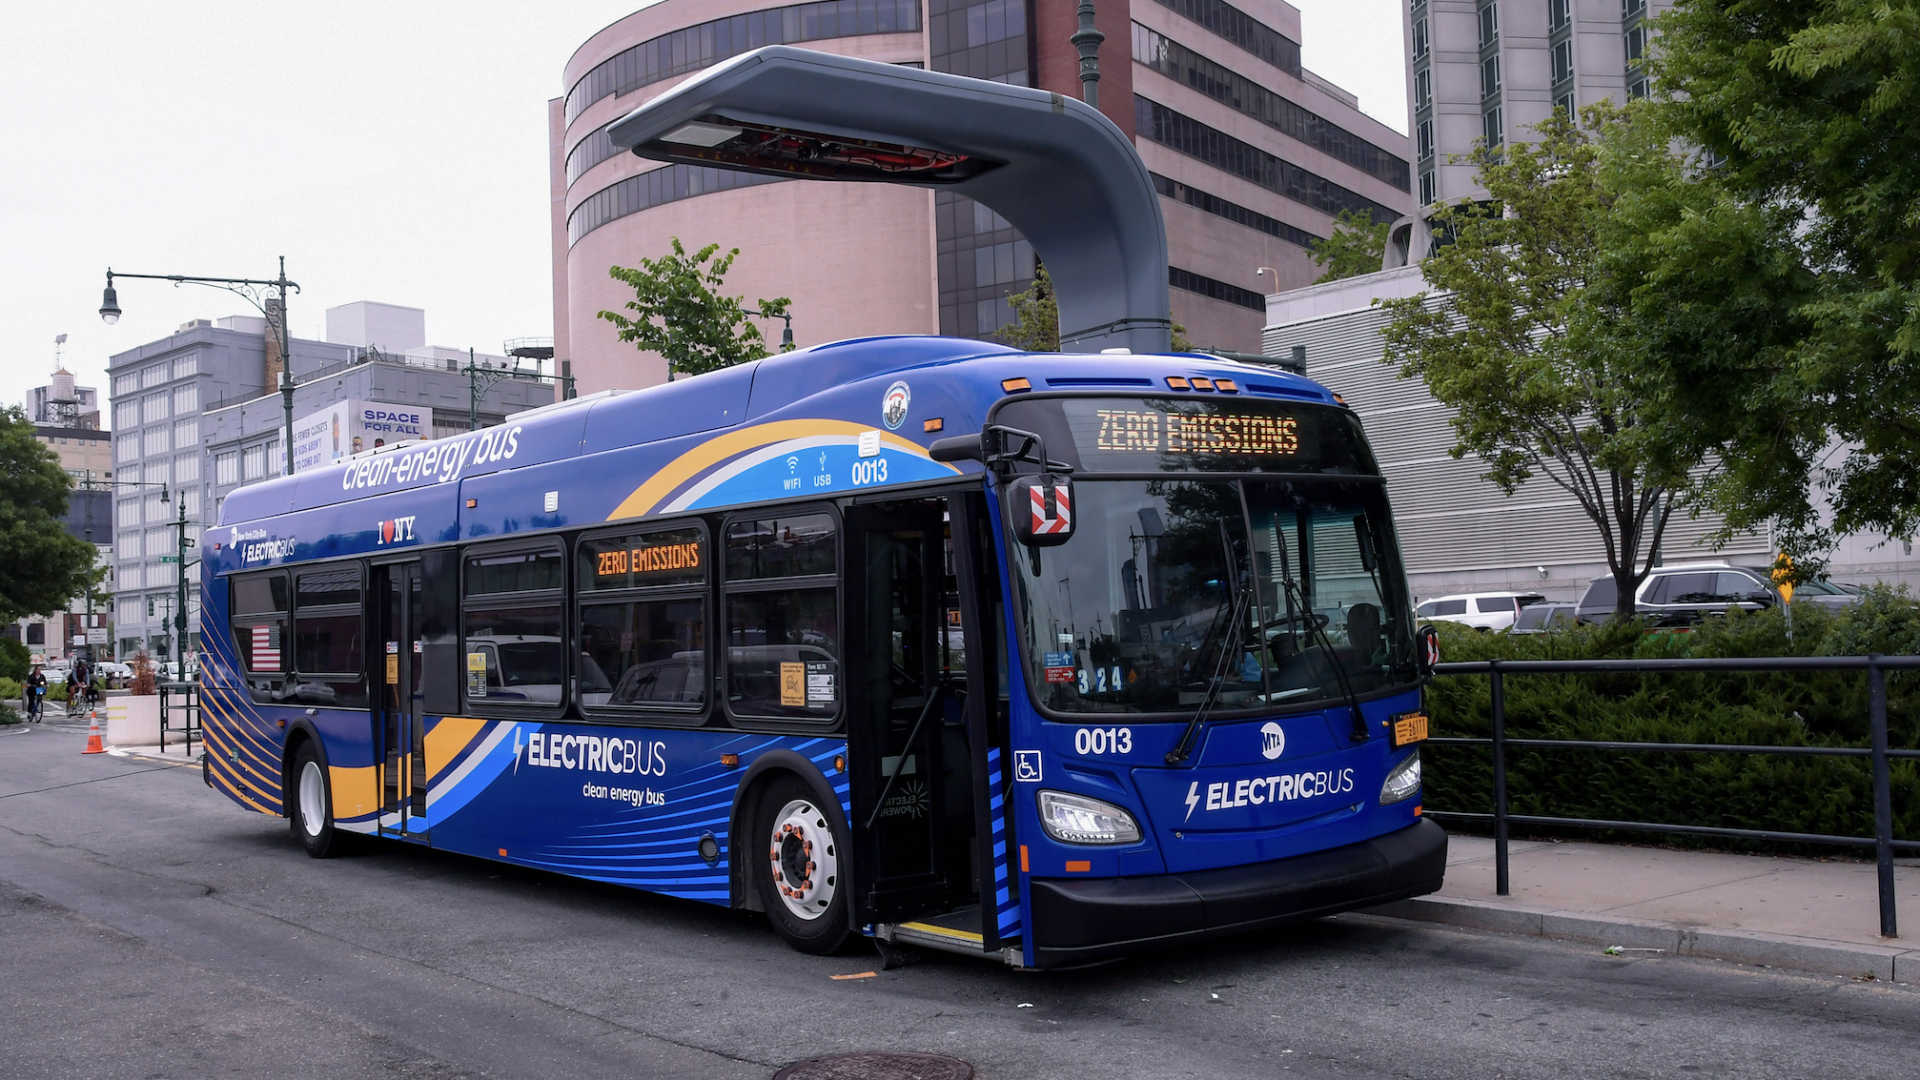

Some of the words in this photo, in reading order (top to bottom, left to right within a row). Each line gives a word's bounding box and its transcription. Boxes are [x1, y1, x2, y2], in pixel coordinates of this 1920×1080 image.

[364, 410, 420, 424] SPACE
[365, 422, 391, 432] FOR
[396, 426, 420, 434] ALL
[298, 429, 310, 442] FEWER
[311, 421, 328, 436] CLOSETS
[1097, 410, 1158, 450] ZERO
[1166, 412, 1298, 454] EMISSIONS
[298, 444, 307, 454] KIDS
[302, 456, 312, 468] COME
[342, 437, 476, 490] clean-energy
[472, 426, 522, 465] bus
[783, 478, 801, 490] WIFI
[814, 474, 831, 487] USB
[852, 458, 888, 485] 0013
[377, 522, 383, 545] I
[394, 516, 416, 542] NY
[598, 550, 628, 576] ZERO
[632, 542, 699, 572] EMISSIONS
[528, 732, 666, 777] ELECTRICBUS
[1075, 728, 1132, 755] 0013
[582, 782, 607, 799] clean
[610, 787, 644, 807] energy
[646, 787, 665, 806] bus
[1206, 768, 1354, 810] ELECTRICBUS
